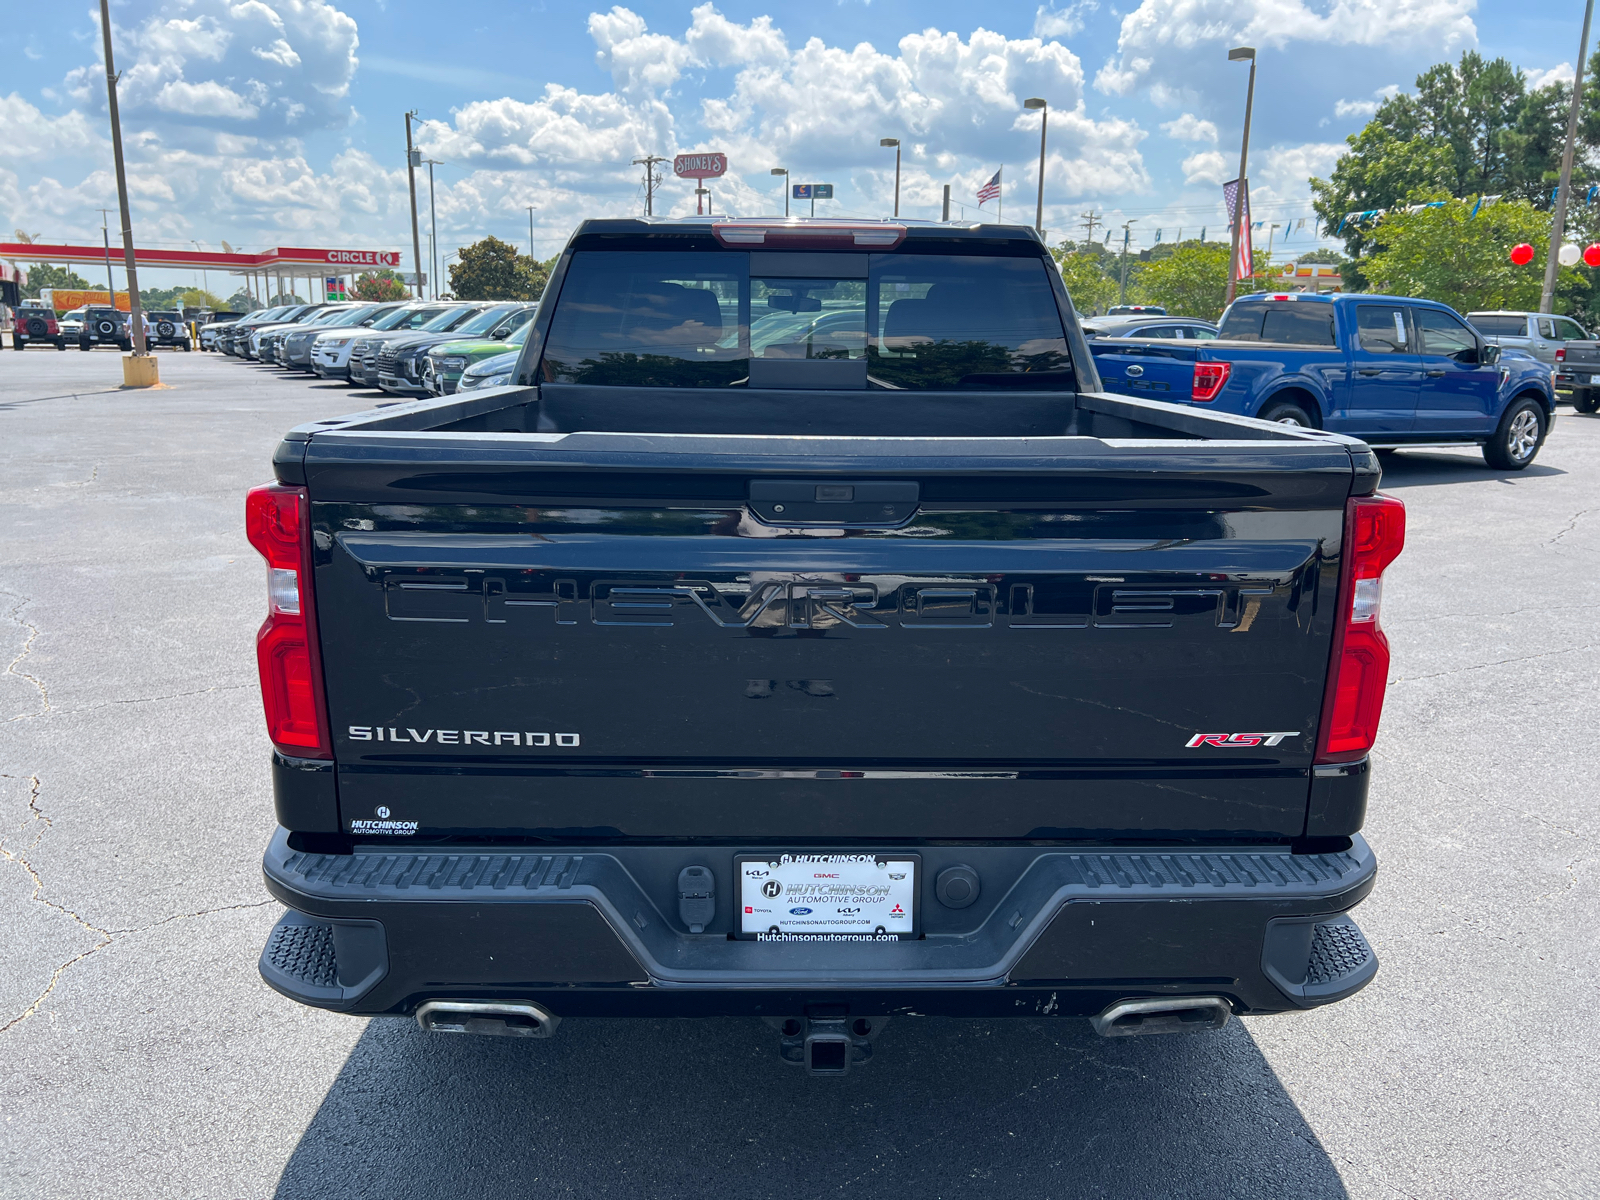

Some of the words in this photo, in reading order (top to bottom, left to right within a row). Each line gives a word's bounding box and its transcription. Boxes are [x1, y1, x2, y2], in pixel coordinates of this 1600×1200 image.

[676, 155, 721, 173] SHONEY'S
[328, 251, 373, 263] CIRCLE
[379, 252, 391, 265] K
[1102, 377, 1170, 391] F-150
[384, 575, 1275, 629] CHEVROLET
[348, 726, 580, 747] SILVERADO
[1185, 731, 1300, 748] RST
[351, 820, 419, 830] HUTCHINSON
[795, 855, 876, 864] HUTCHINSON
[785, 884, 891, 897] HUTCHINSON
[787, 896, 849, 904] AUTOMOTIVE
[852, 896, 886, 904] GROUP
[757, 932, 898, 941] Hutchinsonautogroup.com
